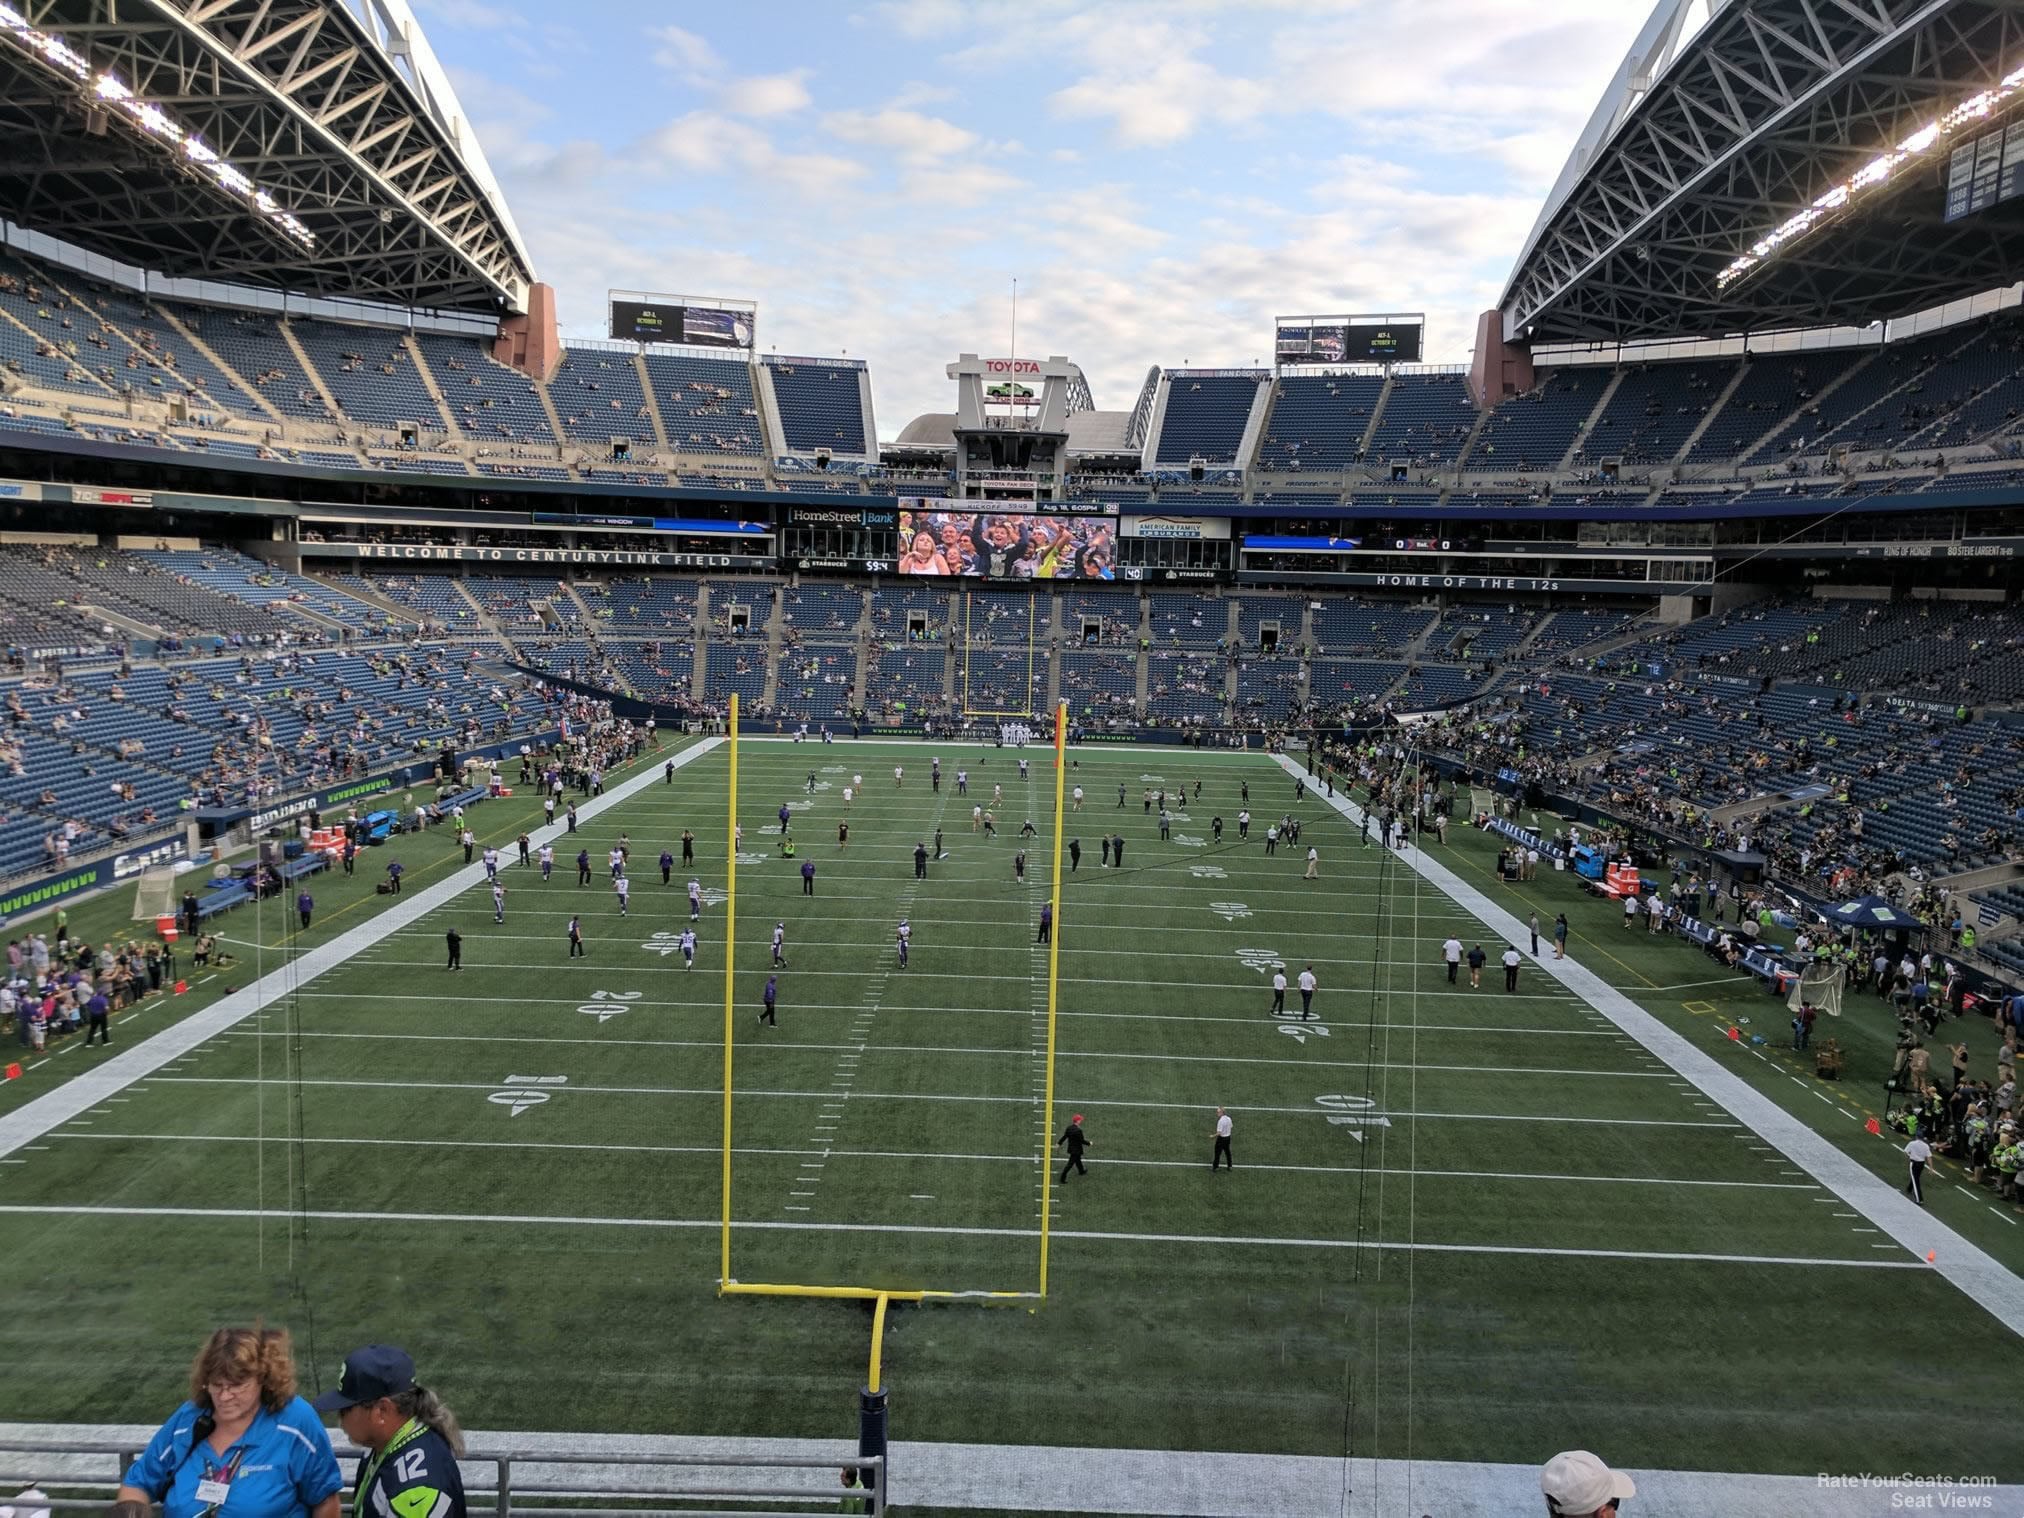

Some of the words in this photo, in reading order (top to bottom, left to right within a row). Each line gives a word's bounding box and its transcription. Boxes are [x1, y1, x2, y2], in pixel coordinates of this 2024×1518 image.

[986, 361, 1040, 373] TOYOTA
[868, 512, 893, 524] Bank
[1140, 524, 1175, 532] AMERICAN
[1176, 524, 1201, 532] FAMILY
[1396, 540, 1404, 549] 0
[1442, 541, 1450, 550] 0
[358, 545, 463, 560] WELCOME
[477, 549, 502, 560] TO
[516, 549, 661, 566] CENTURYLINK
[674, 554, 732, 567] FIELD
[1179, 570, 1216, 578] STARBUCKS
[1376, 575, 1431, 587] HOME
[1443, 577, 1467, 588] OF
[1480, 578, 1516, 589] THE
[1531, 579, 1559, 591] 12s
[393, 1448, 428, 1483] 12
